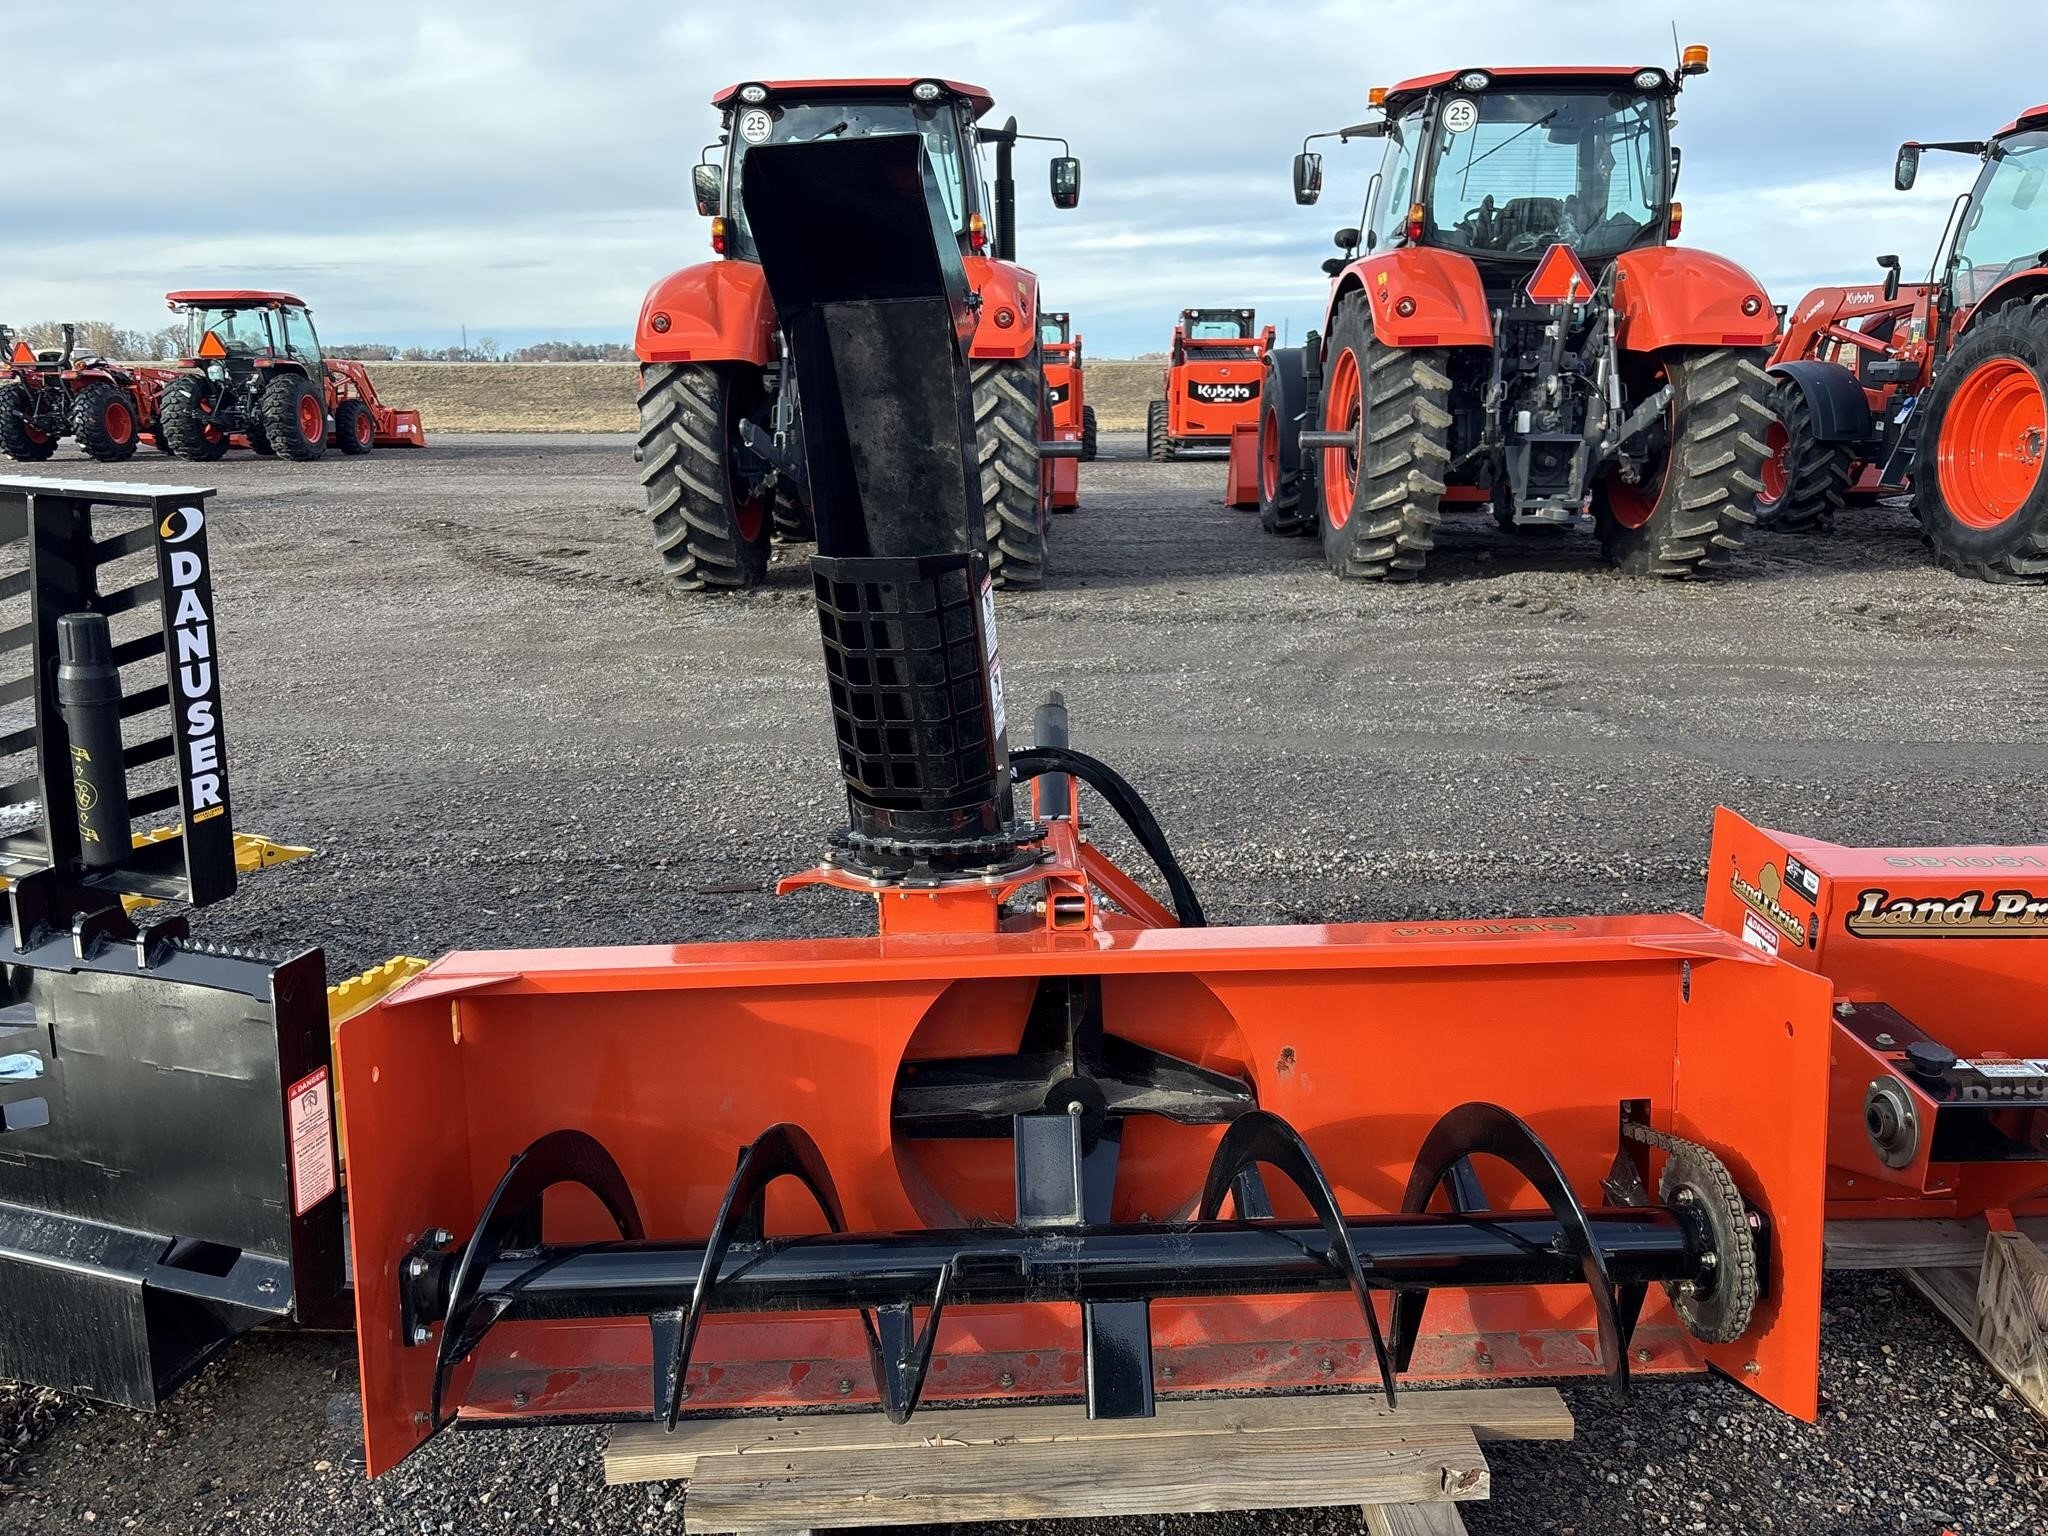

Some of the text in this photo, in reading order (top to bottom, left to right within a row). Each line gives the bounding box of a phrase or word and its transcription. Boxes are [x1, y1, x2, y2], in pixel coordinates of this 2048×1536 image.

[1450, 107, 1470, 120] 25
[747, 117, 765, 130] 25
[1846, 291, 1875, 304] Kubota
[1197, 384, 1250, 398] Kubota
[170, 550, 224, 811] DANUSER
[1884, 856, 2046, 868] SB1051
[1731, 868, 1764, 908] Land
[1769, 898, 1805, 939] Pride
[1853, 892, 2048, 925] Land Pr
[1392, 922, 1577, 936] SB1064
[1751, 918, 1777, 945] DANGER
[297, 1070, 326, 1092] DANGER
